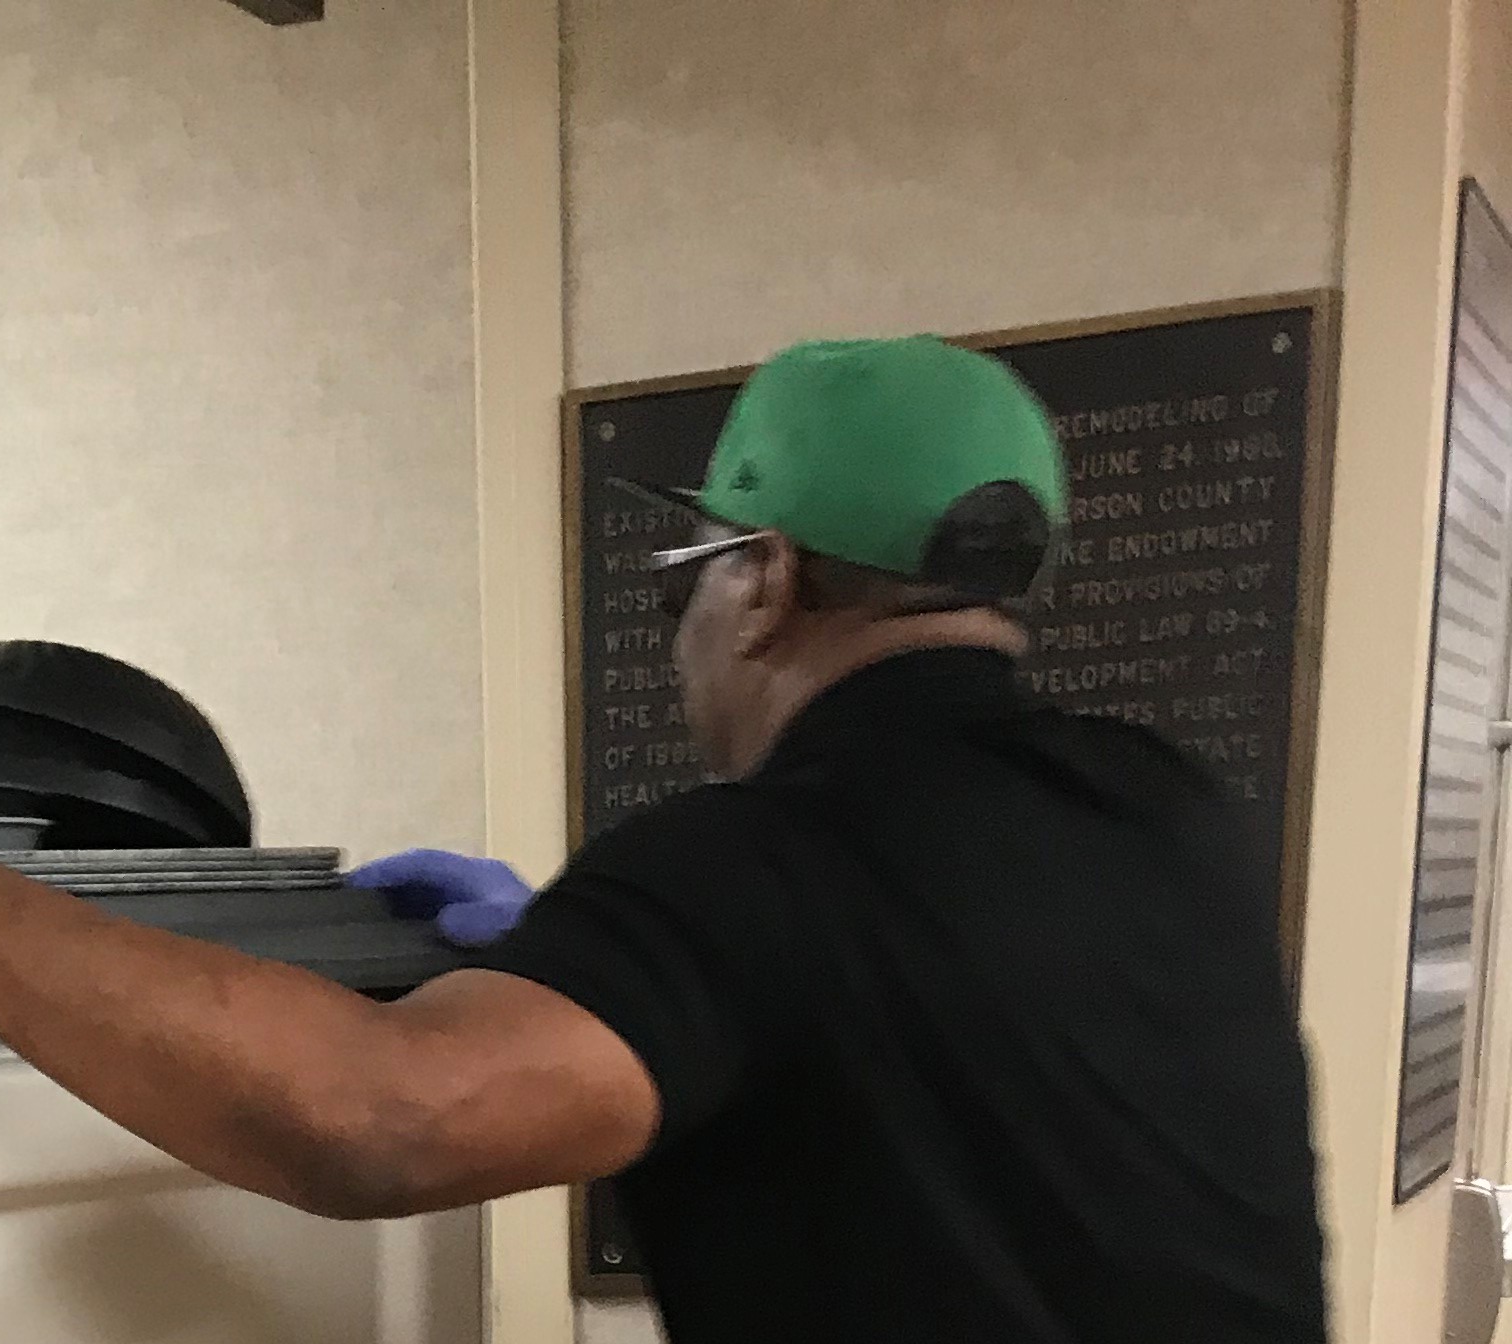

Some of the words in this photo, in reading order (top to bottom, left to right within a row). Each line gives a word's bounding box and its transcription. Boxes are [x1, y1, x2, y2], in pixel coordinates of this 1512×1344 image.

[1055, 394, 1229, 440] REMODELING
[1243, 387, 1280, 417] OF
[603, 507, 697, 537] EXISTIN
[1072, 447, 1142, 480] JUNE
[1072, 491, 1142, 524] RSON
[1158, 476, 1275, 513] COUNTY
[604, 588, 665, 614] HOSP
[1107, 518, 1273, 562] ENDOWMENT
[604, 627, 661, 654] WITH
[1069, 567, 1225, 606] PROVISIONS
[1236, 562, 1271, 591] OF
[604, 664, 681, 693] PUBLIC
[1040, 619, 1126, 652] PUBLIC
[1139, 611, 1195, 642] LAW
[605, 704, 652, 730] THE
[1213, 647, 1264, 676] ACT
[604, 744, 635, 770] OF
[1172, 692, 1264, 721] PUBLIC
